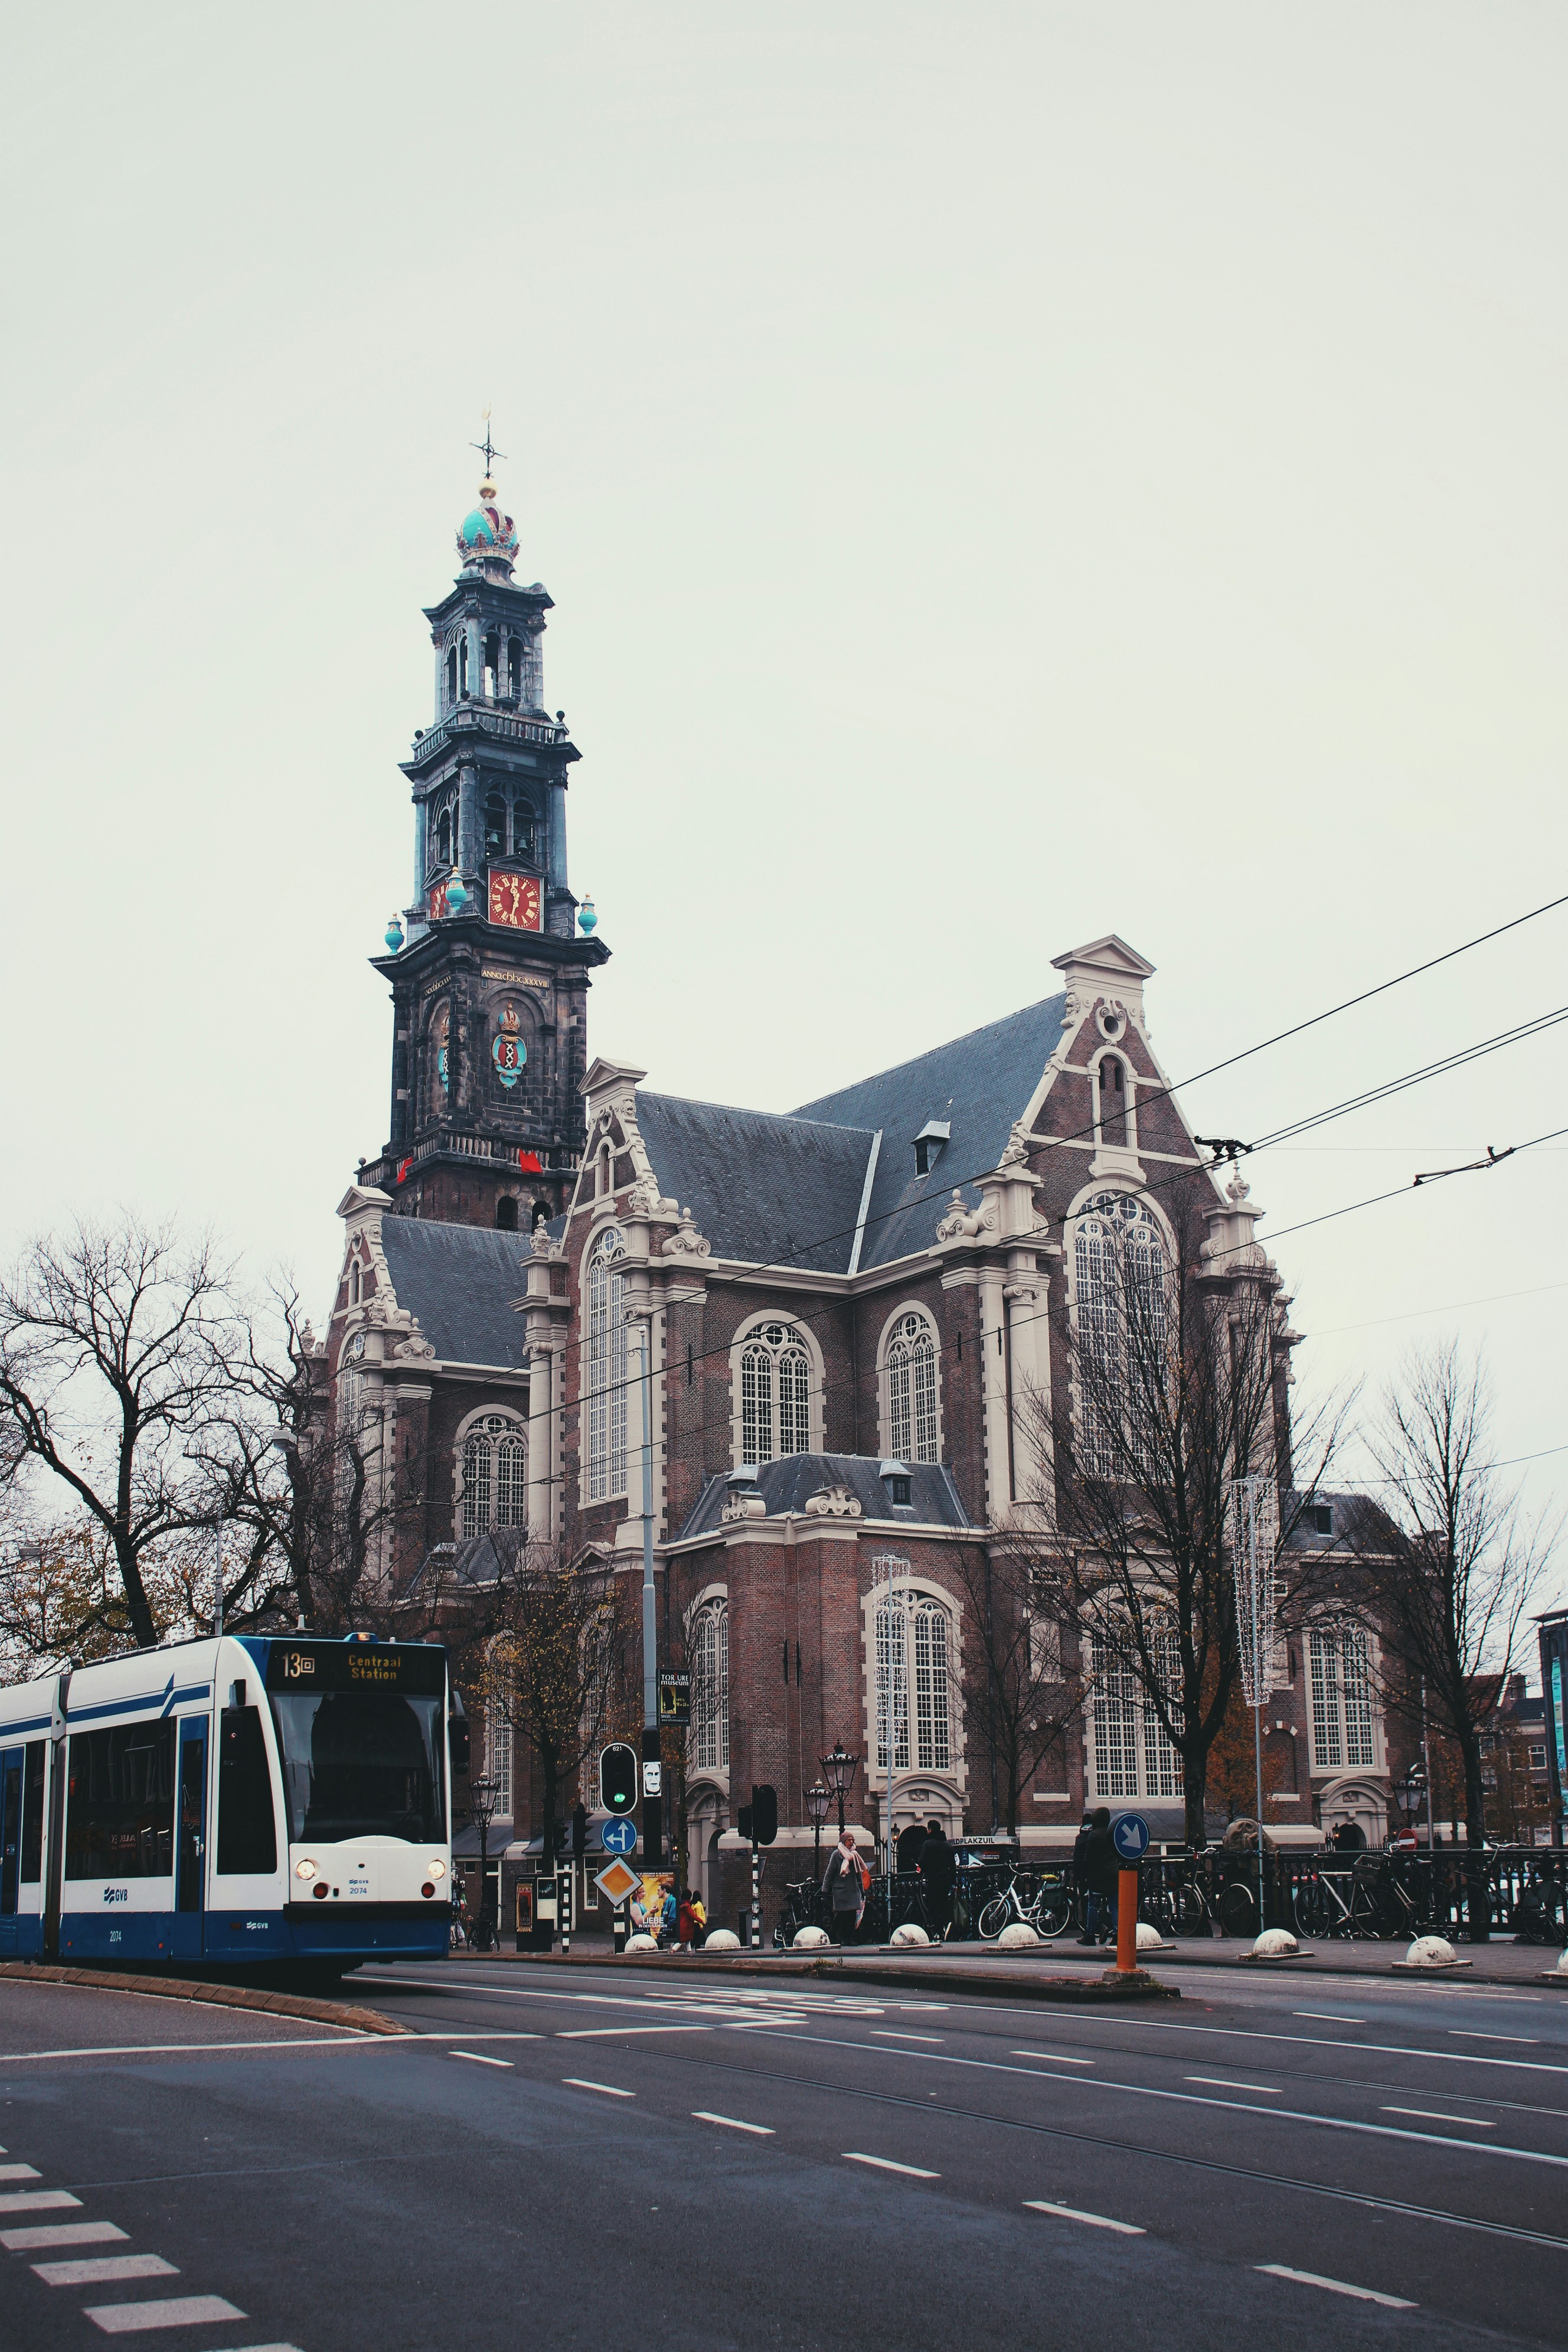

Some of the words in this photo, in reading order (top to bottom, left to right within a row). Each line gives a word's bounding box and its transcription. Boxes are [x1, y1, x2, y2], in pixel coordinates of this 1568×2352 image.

[282, 1652, 300, 1678] 13
[348, 1655, 401, 1668] Centraal
[351, 1668, 397, 1680] Station
[115, 1889, 128, 1902] GVB
[110, 1930, 122, 1942] 2074
